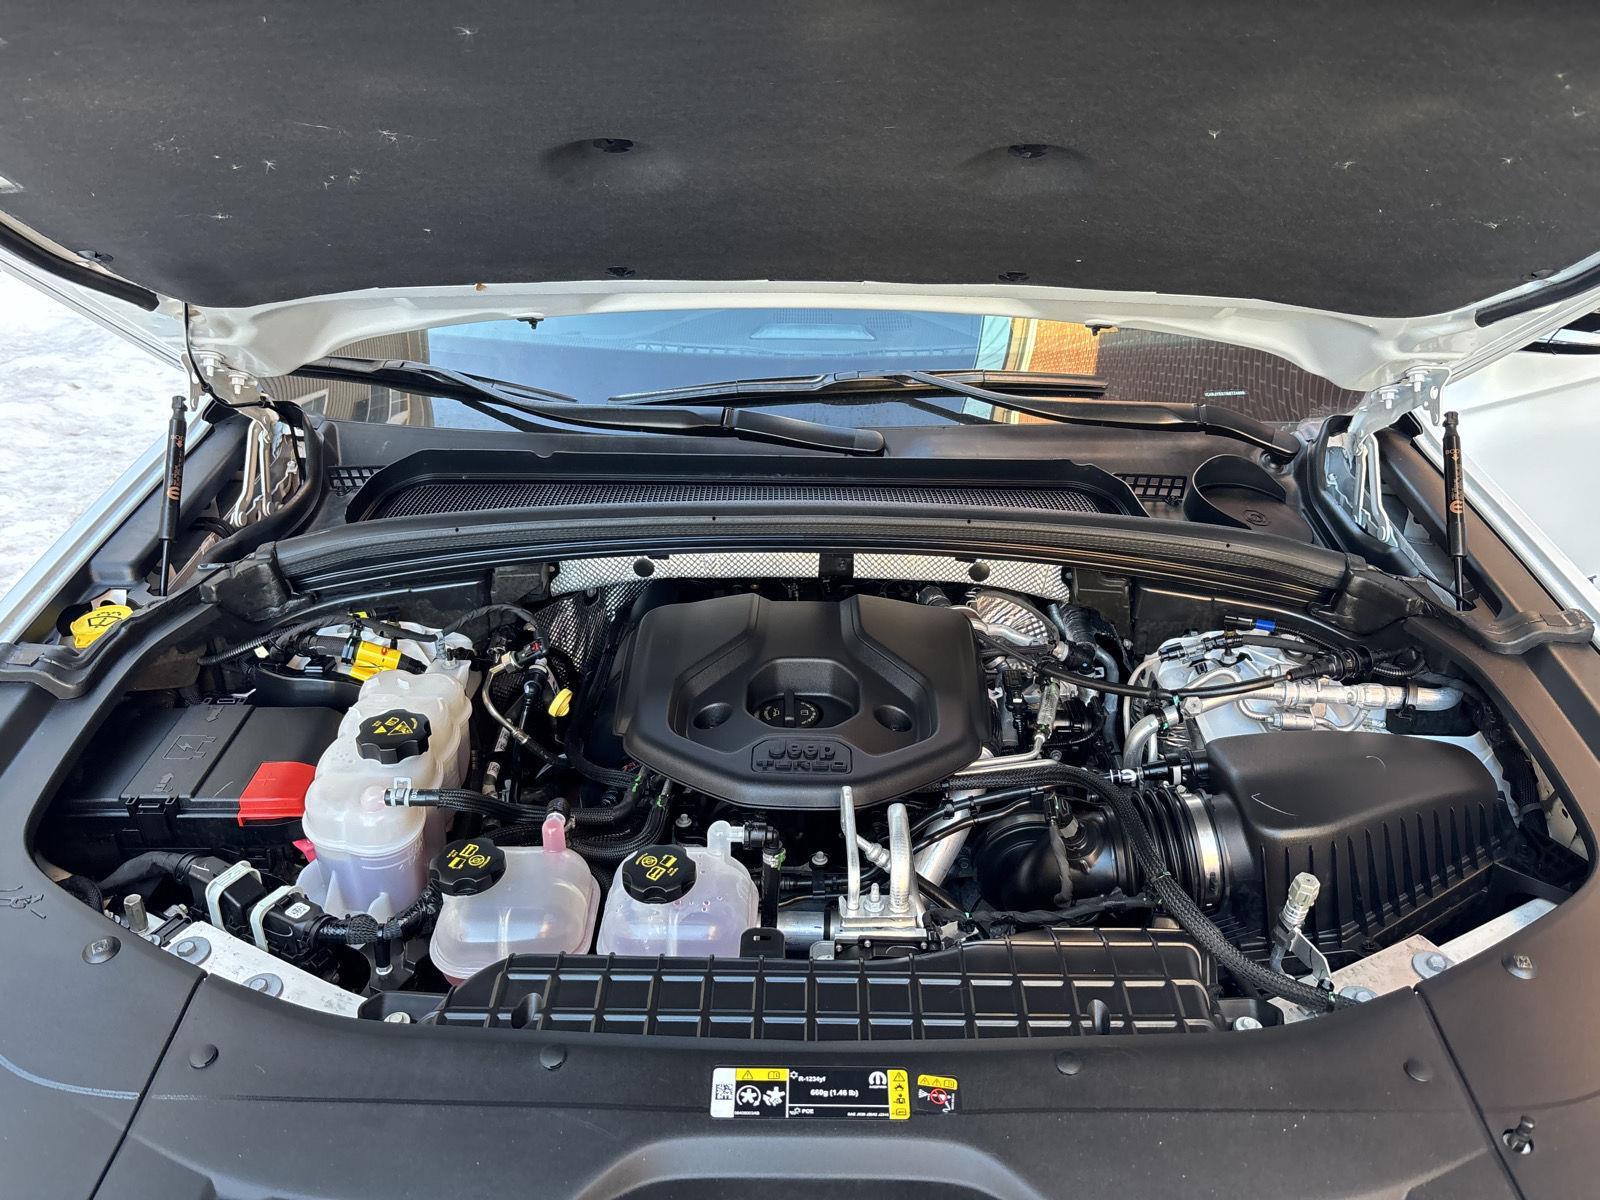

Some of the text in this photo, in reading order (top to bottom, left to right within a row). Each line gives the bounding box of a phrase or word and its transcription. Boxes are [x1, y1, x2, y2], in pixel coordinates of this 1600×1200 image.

[768, 740, 836, 760] Jeep
[797, 1075, 826, 1083] R-1234yf
[848, 1089, 859, 1097] lb)
